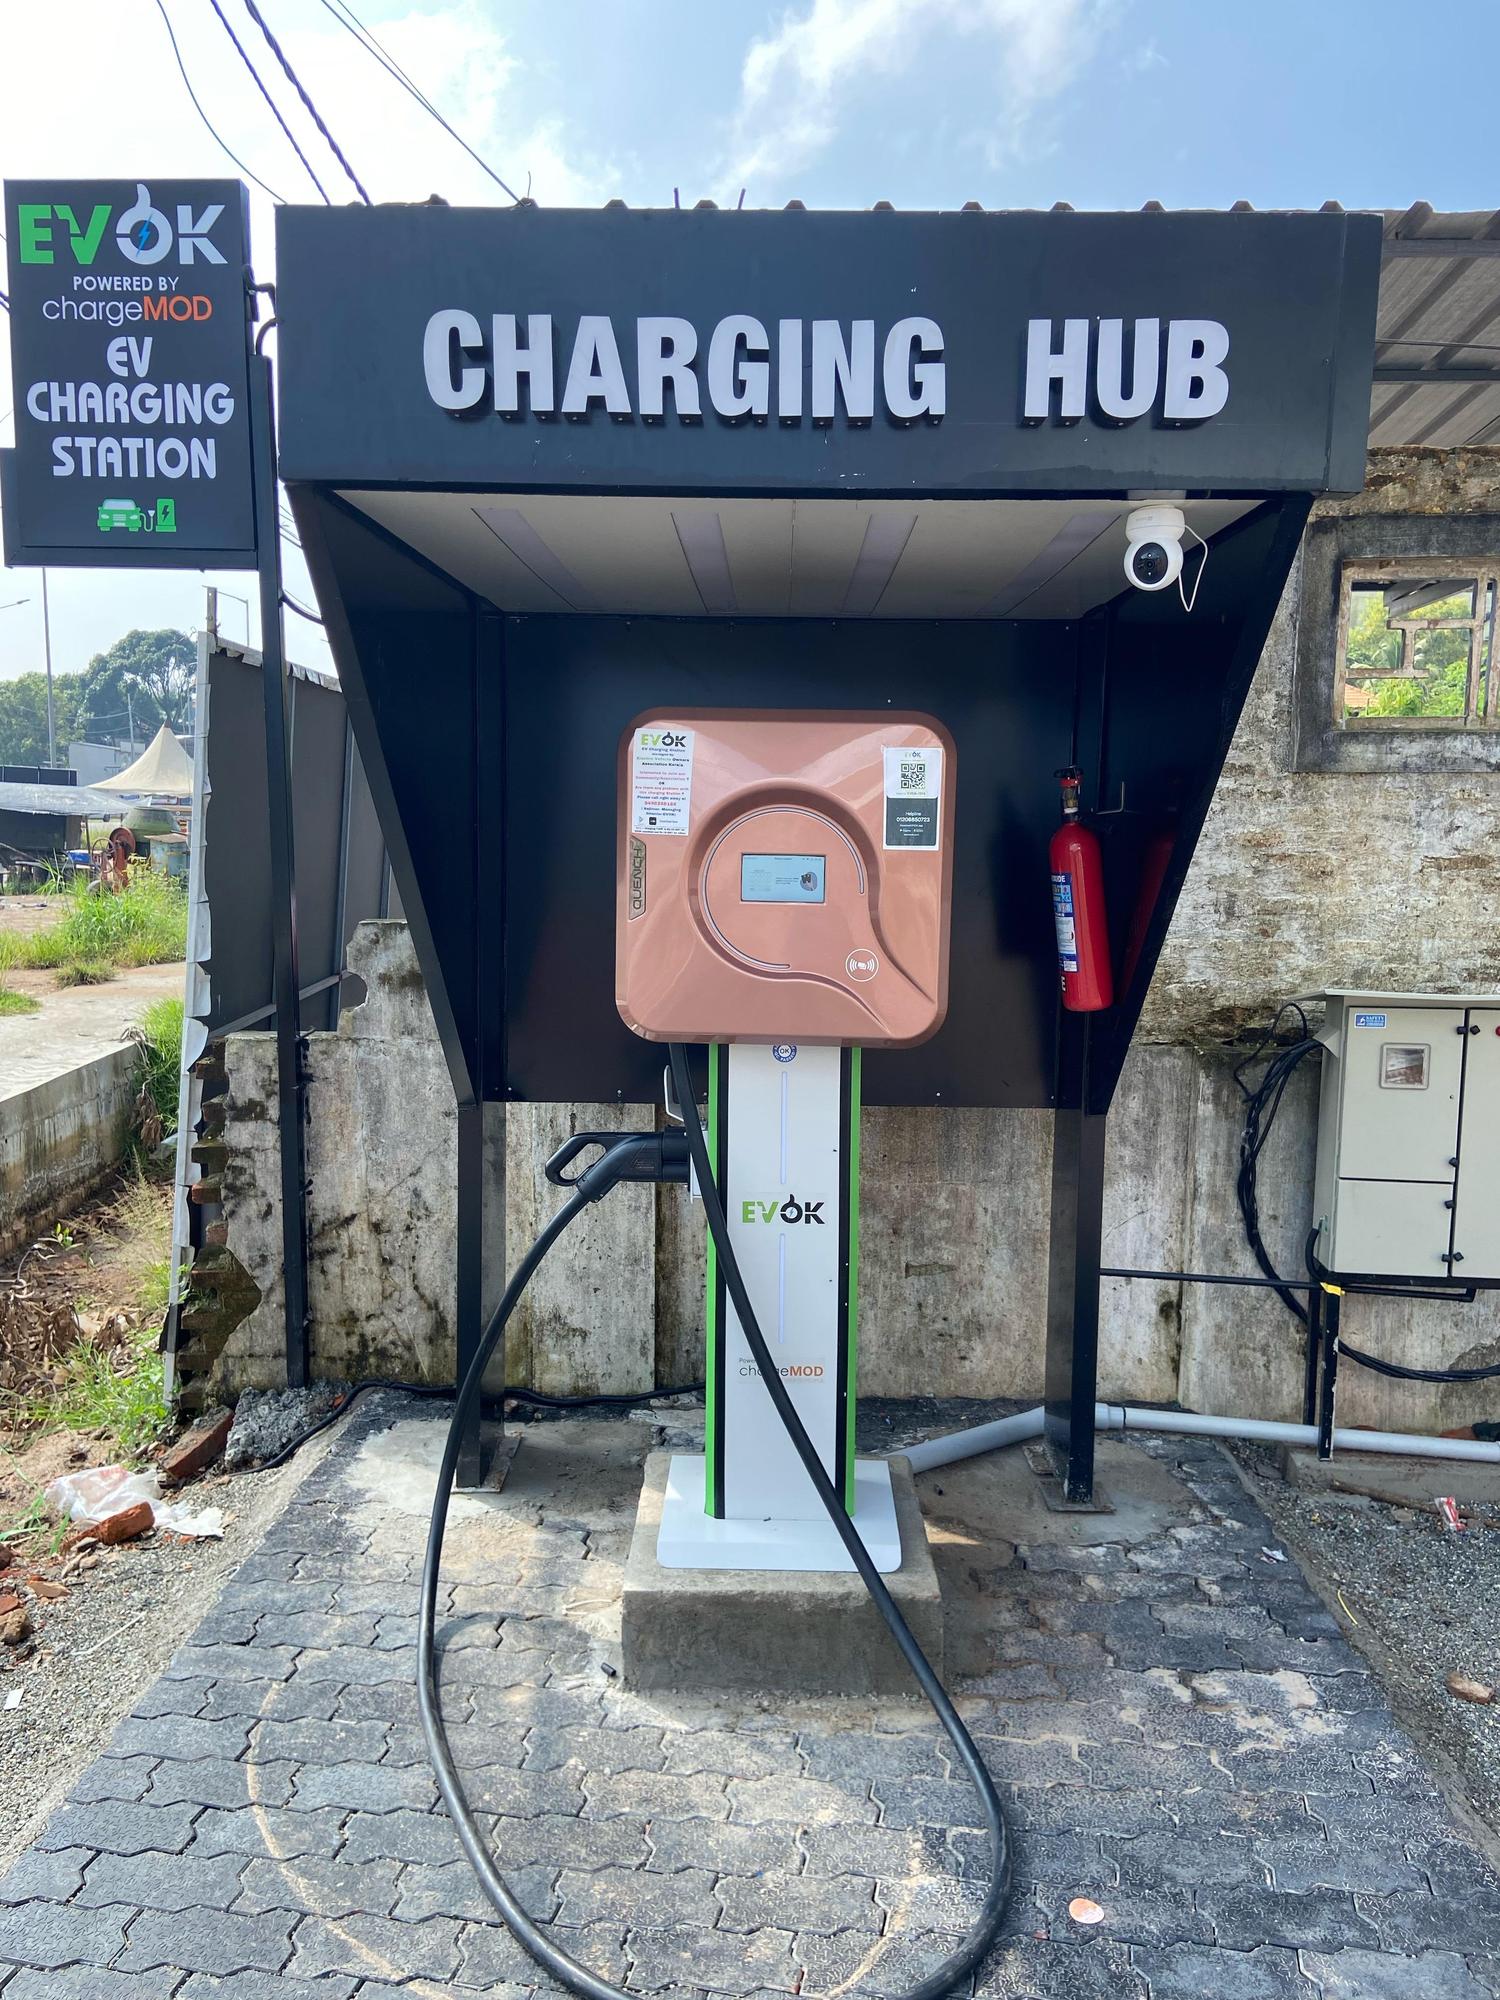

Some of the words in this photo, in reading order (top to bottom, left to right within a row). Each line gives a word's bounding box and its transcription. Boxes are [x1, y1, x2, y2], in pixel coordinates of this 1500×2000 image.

[18, 183, 228, 265] EVOK
[73, 276, 153, 292] POWERED
[158, 276, 180, 291] BY
[42, 295, 212, 327] chargeMOD
[106, 336, 153, 378] EV
[422, 309, 945, 418] CHARGING
[1024, 317, 1230, 419] HUB
[26, 381, 235, 425] CHARGING
[51, 436, 217, 480] STATION
[641, 732, 687, 747] EVOK
[742, 1193, 825, 1225] EVOK
